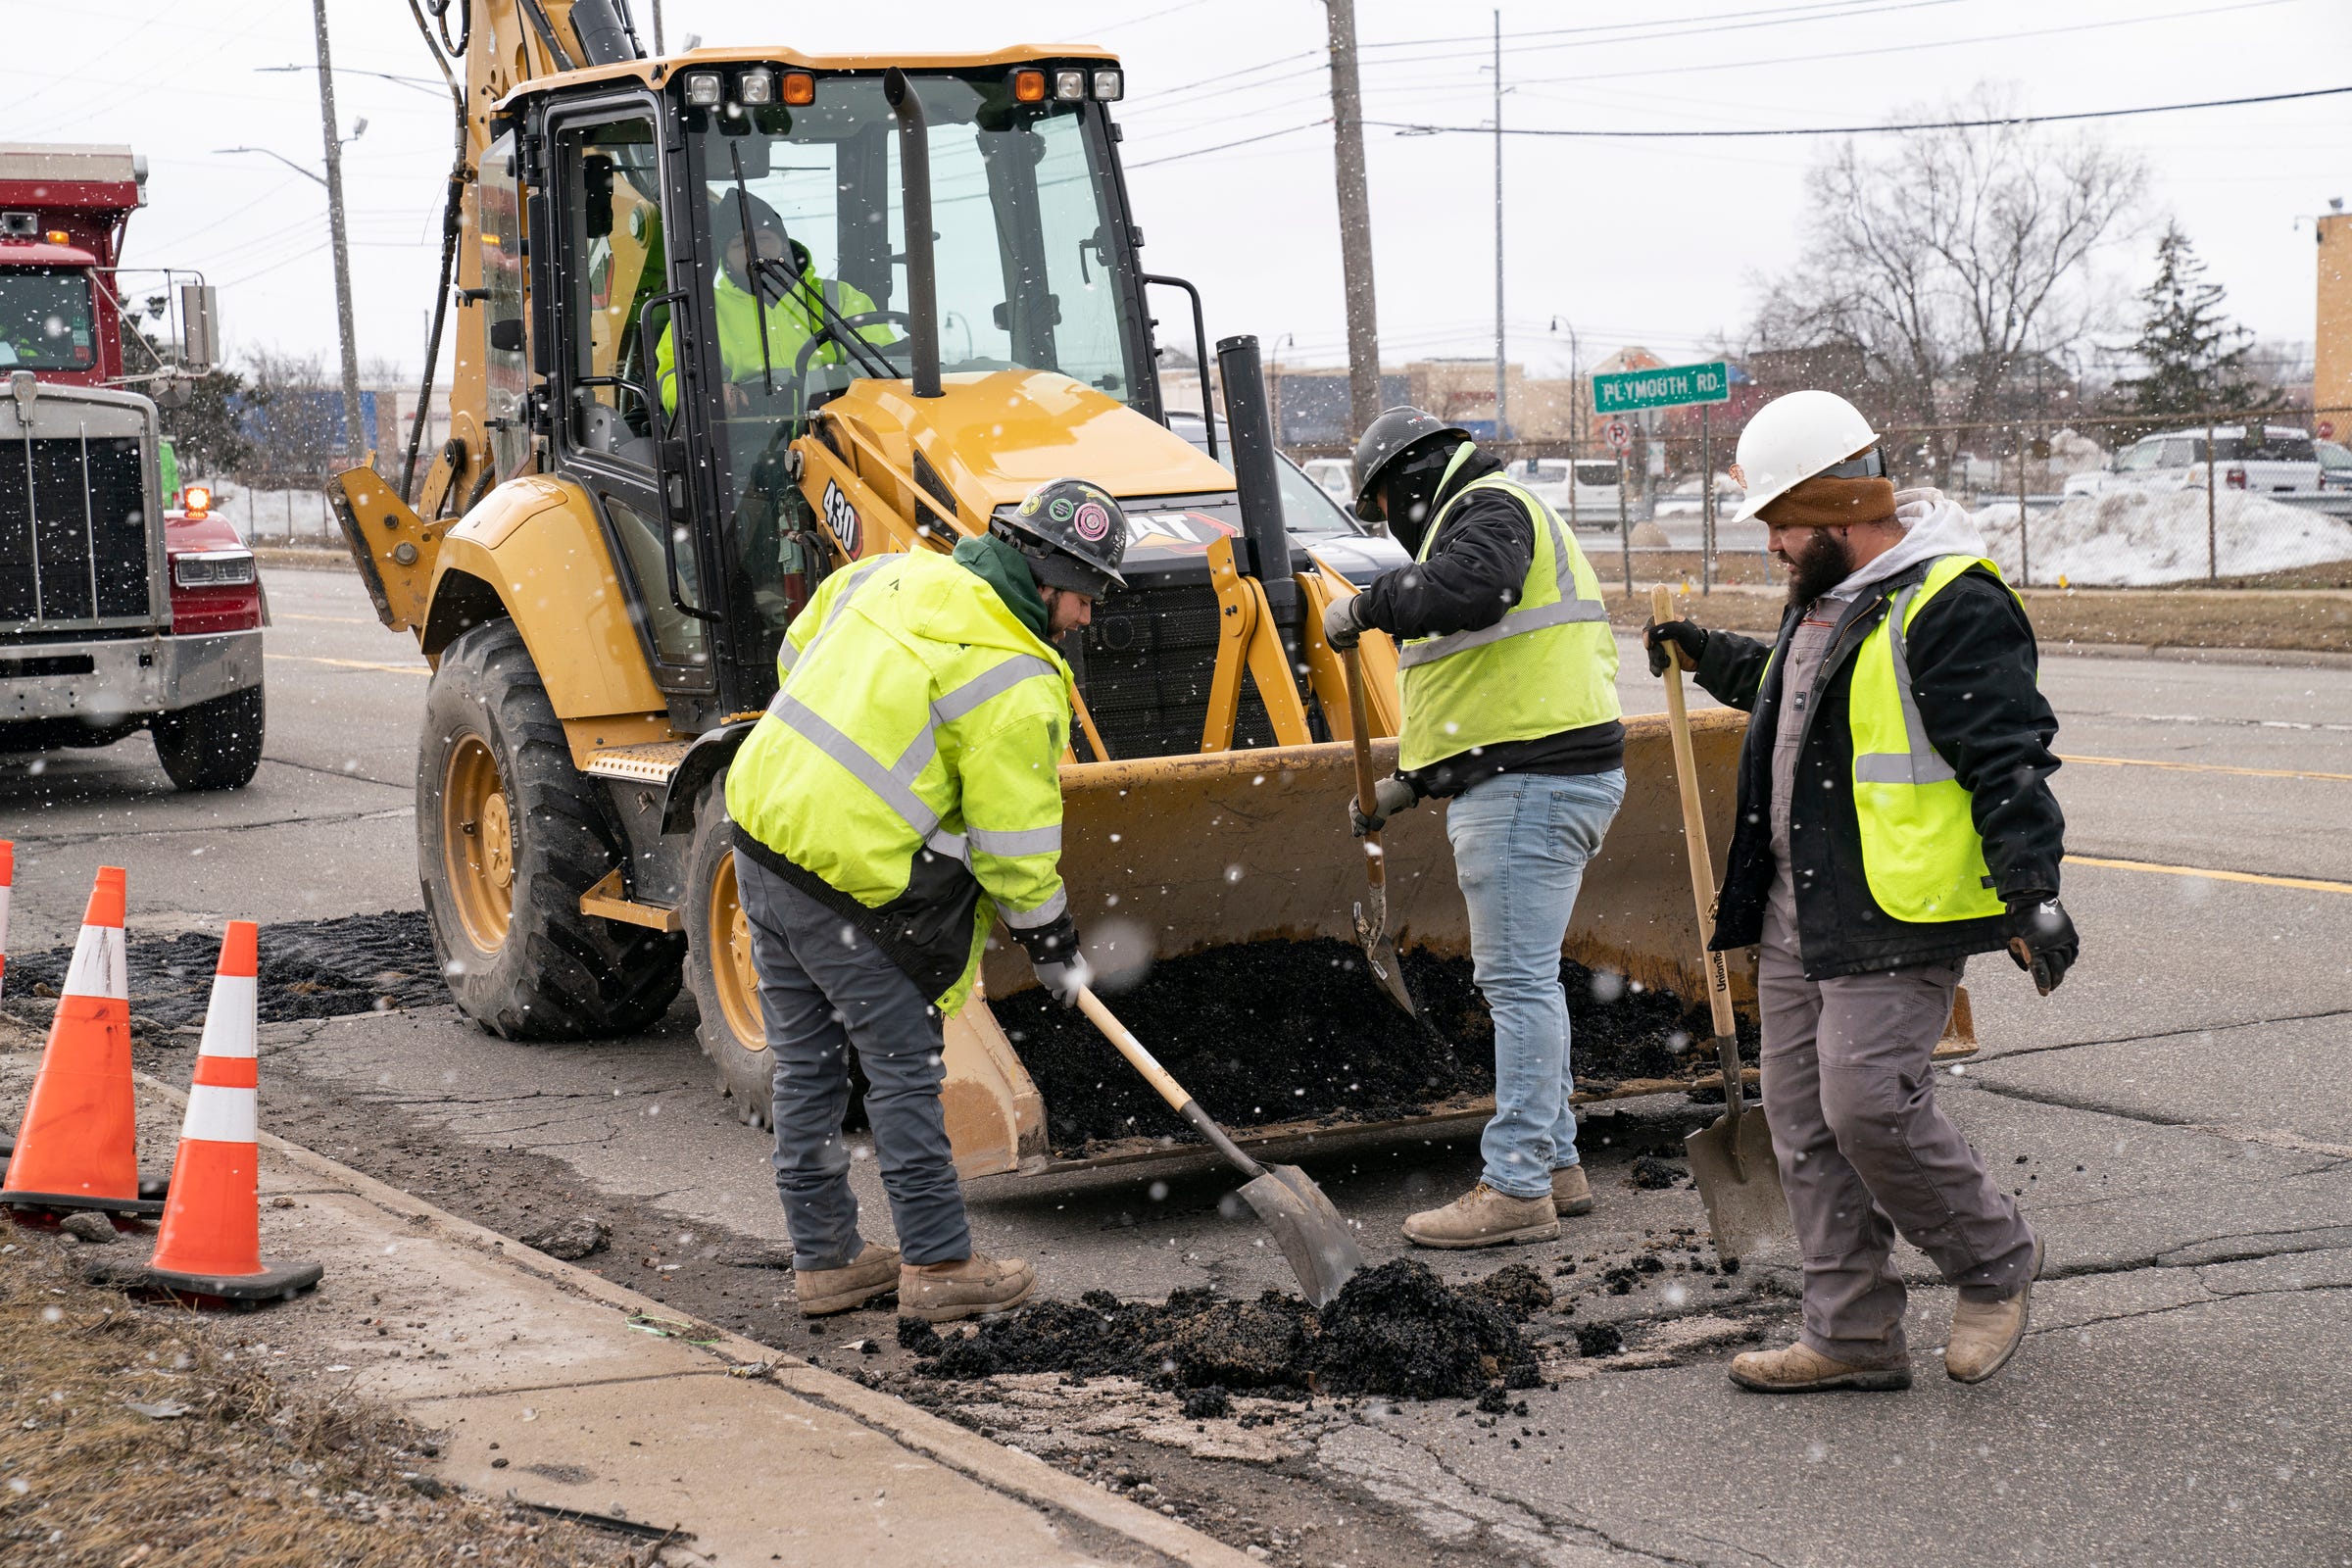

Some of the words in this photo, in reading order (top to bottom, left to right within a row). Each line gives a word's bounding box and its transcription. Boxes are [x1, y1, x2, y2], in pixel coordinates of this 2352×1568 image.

[1603, 375, 1688, 403] PLYMOUTH
[1696, 372, 1718, 392] RD
[823, 479, 856, 551] 430
[1125, 514, 1202, 548] AT
[511, 819, 519, 849] IND
